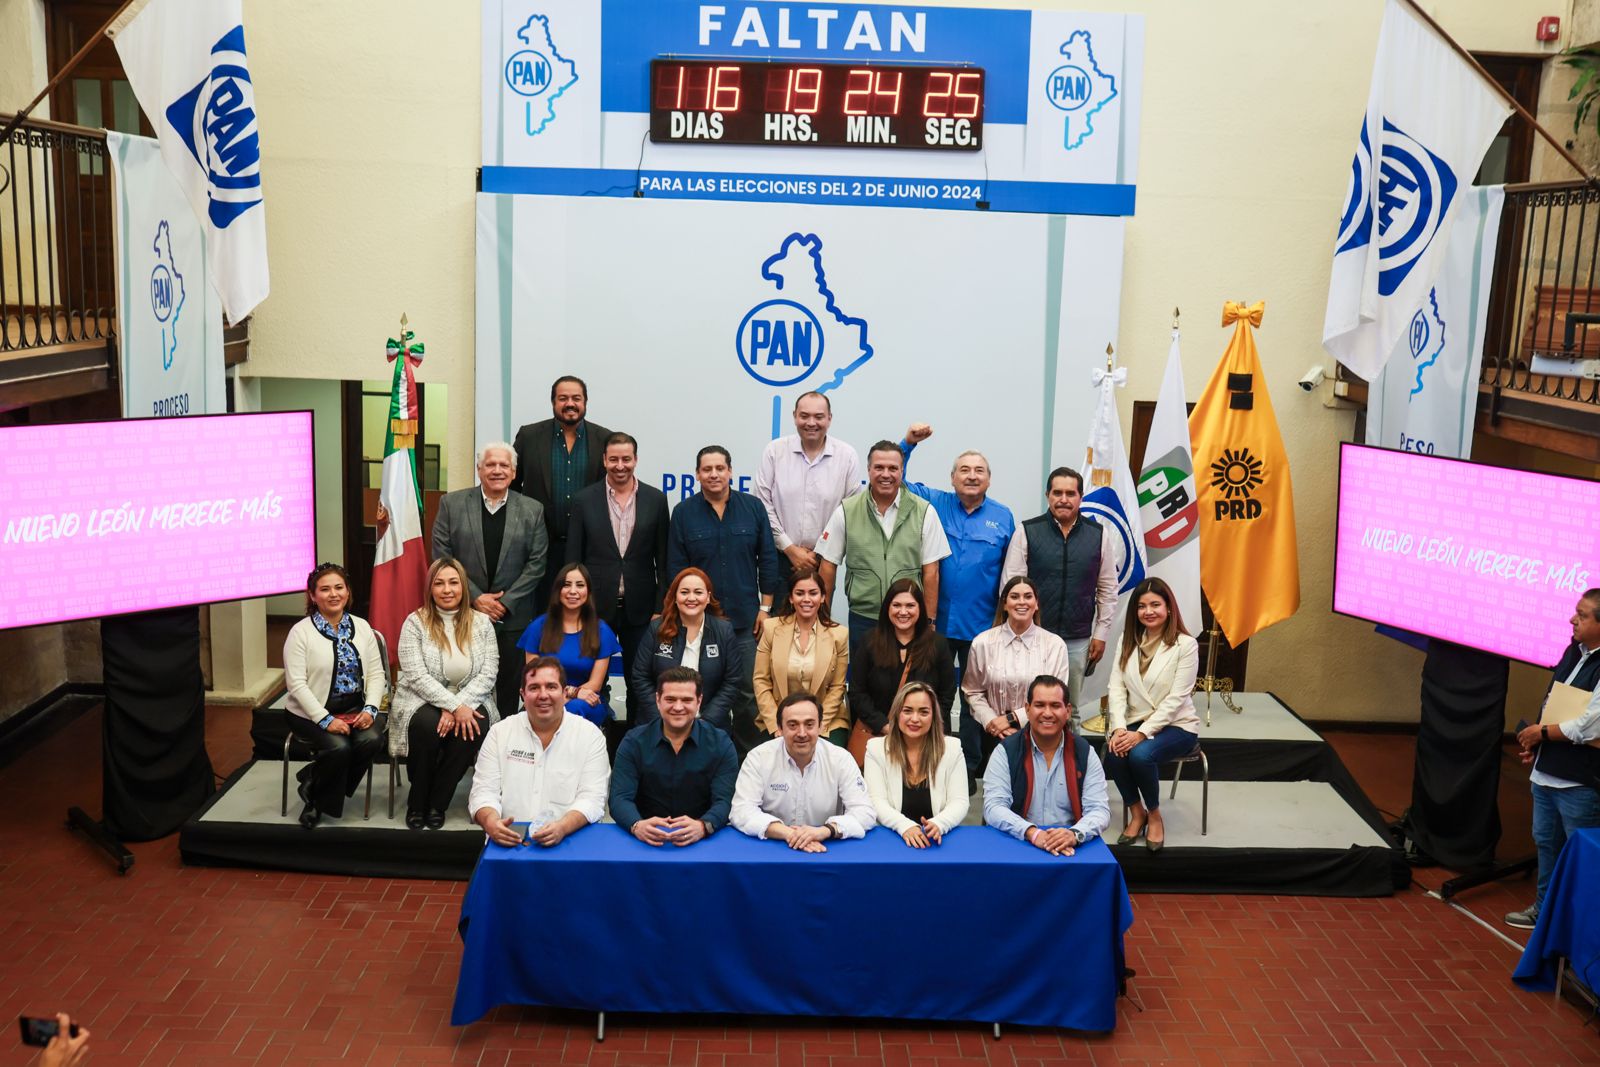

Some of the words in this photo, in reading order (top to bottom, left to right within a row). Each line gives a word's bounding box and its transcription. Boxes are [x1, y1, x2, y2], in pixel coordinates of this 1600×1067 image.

[699, 5, 927, 52] FALTAN
[512, 60, 546, 86] PAN
[1053, 75, 1086, 101] PAN
[784, 68, 822, 113] 19
[843, 70, 902, 115] 24
[922, 72, 981, 118] 25
[670, 111, 725, 139] DIAS
[764, 113, 819, 142] HRS.
[846, 116, 897, 144] MIN.
[924, 117, 978, 146] SEG.
[639, 176, 683, 192] PARA
[687, 178, 716, 192] LAS
[720, 179, 817, 195] ELECCIONES
[821, 182, 848, 196] DEL
[852, 182, 862, 196] 2
[865, 183, 885, 197] DE
[889, 184, 939, 199] JUNIO
[942, 185, 982, 200] 2024
[154, 277, 171, 309] PAN
[750, 319, 812, 367] PAN
[153, 393, 190, 417] PROCESO
[4, 512, 80, 544] NUEVO
[87, 501, 146, 537] LEÓN
[150, 498, 236, 530] MERECE
[239, 489, 283, 521] MÁS
[1136, 469, 1190, 543] PRI
[1214, 498, 1262, 522] PRD
[1361, 527, 1414, 556] NUEVO
[1416, 535, 1463, 568] LEÓN
[1465, 549, 1543, 584] MERECE
[1544, 561, 1591, 593] MÁS
